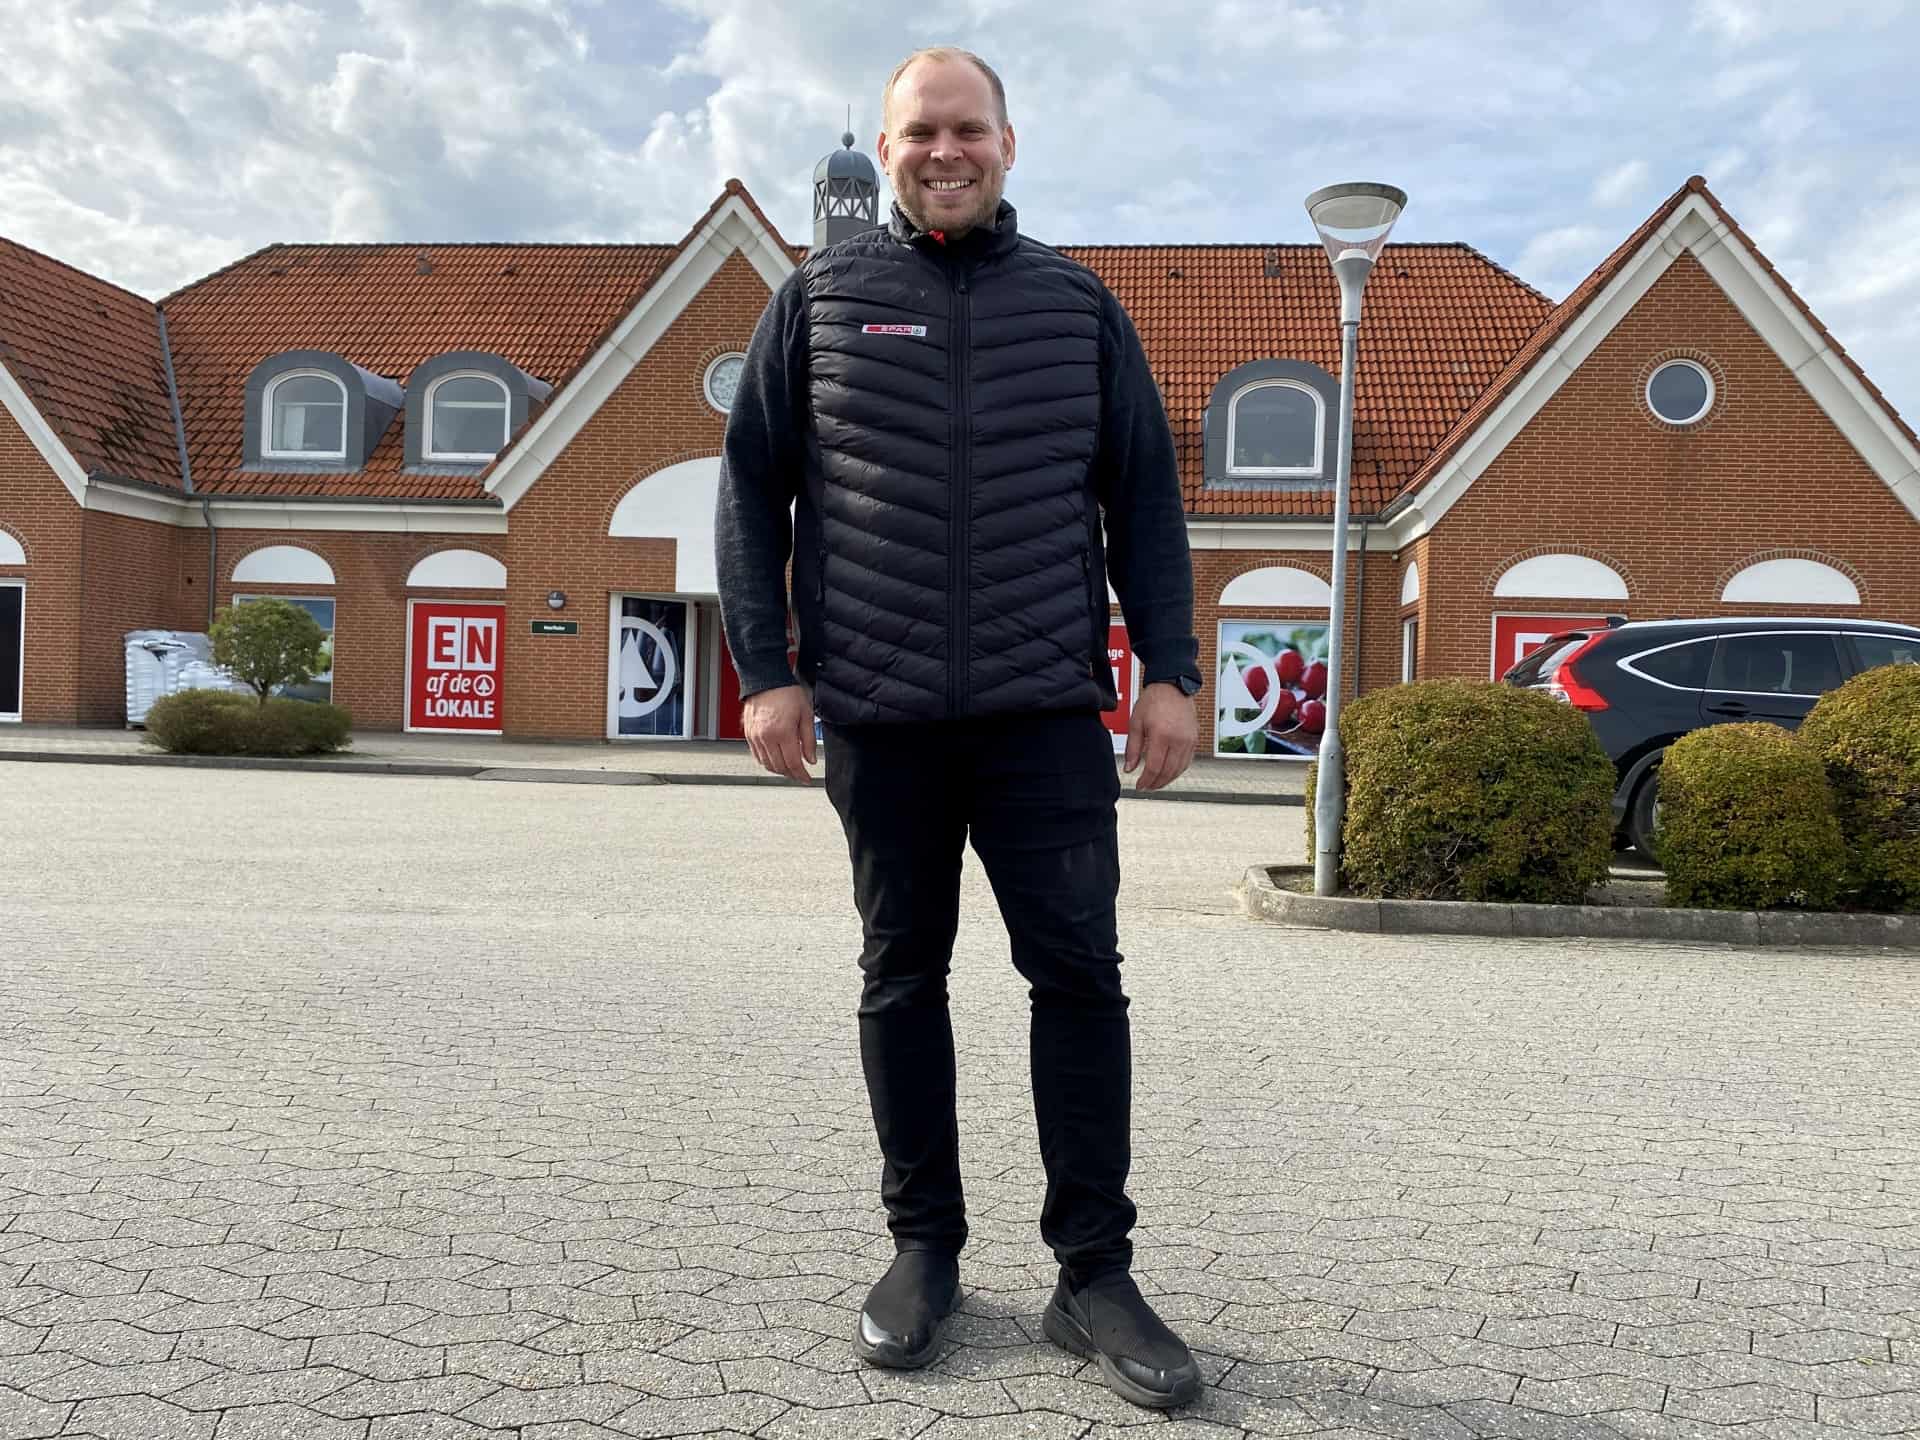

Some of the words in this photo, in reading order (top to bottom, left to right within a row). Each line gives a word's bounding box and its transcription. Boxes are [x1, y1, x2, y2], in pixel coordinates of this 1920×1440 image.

[434, 624, 493, 664] EN
[427, 672, 449, 698] af
[449, 673, 471, 693] de
[425, 698, 495, 719] LOKALE
